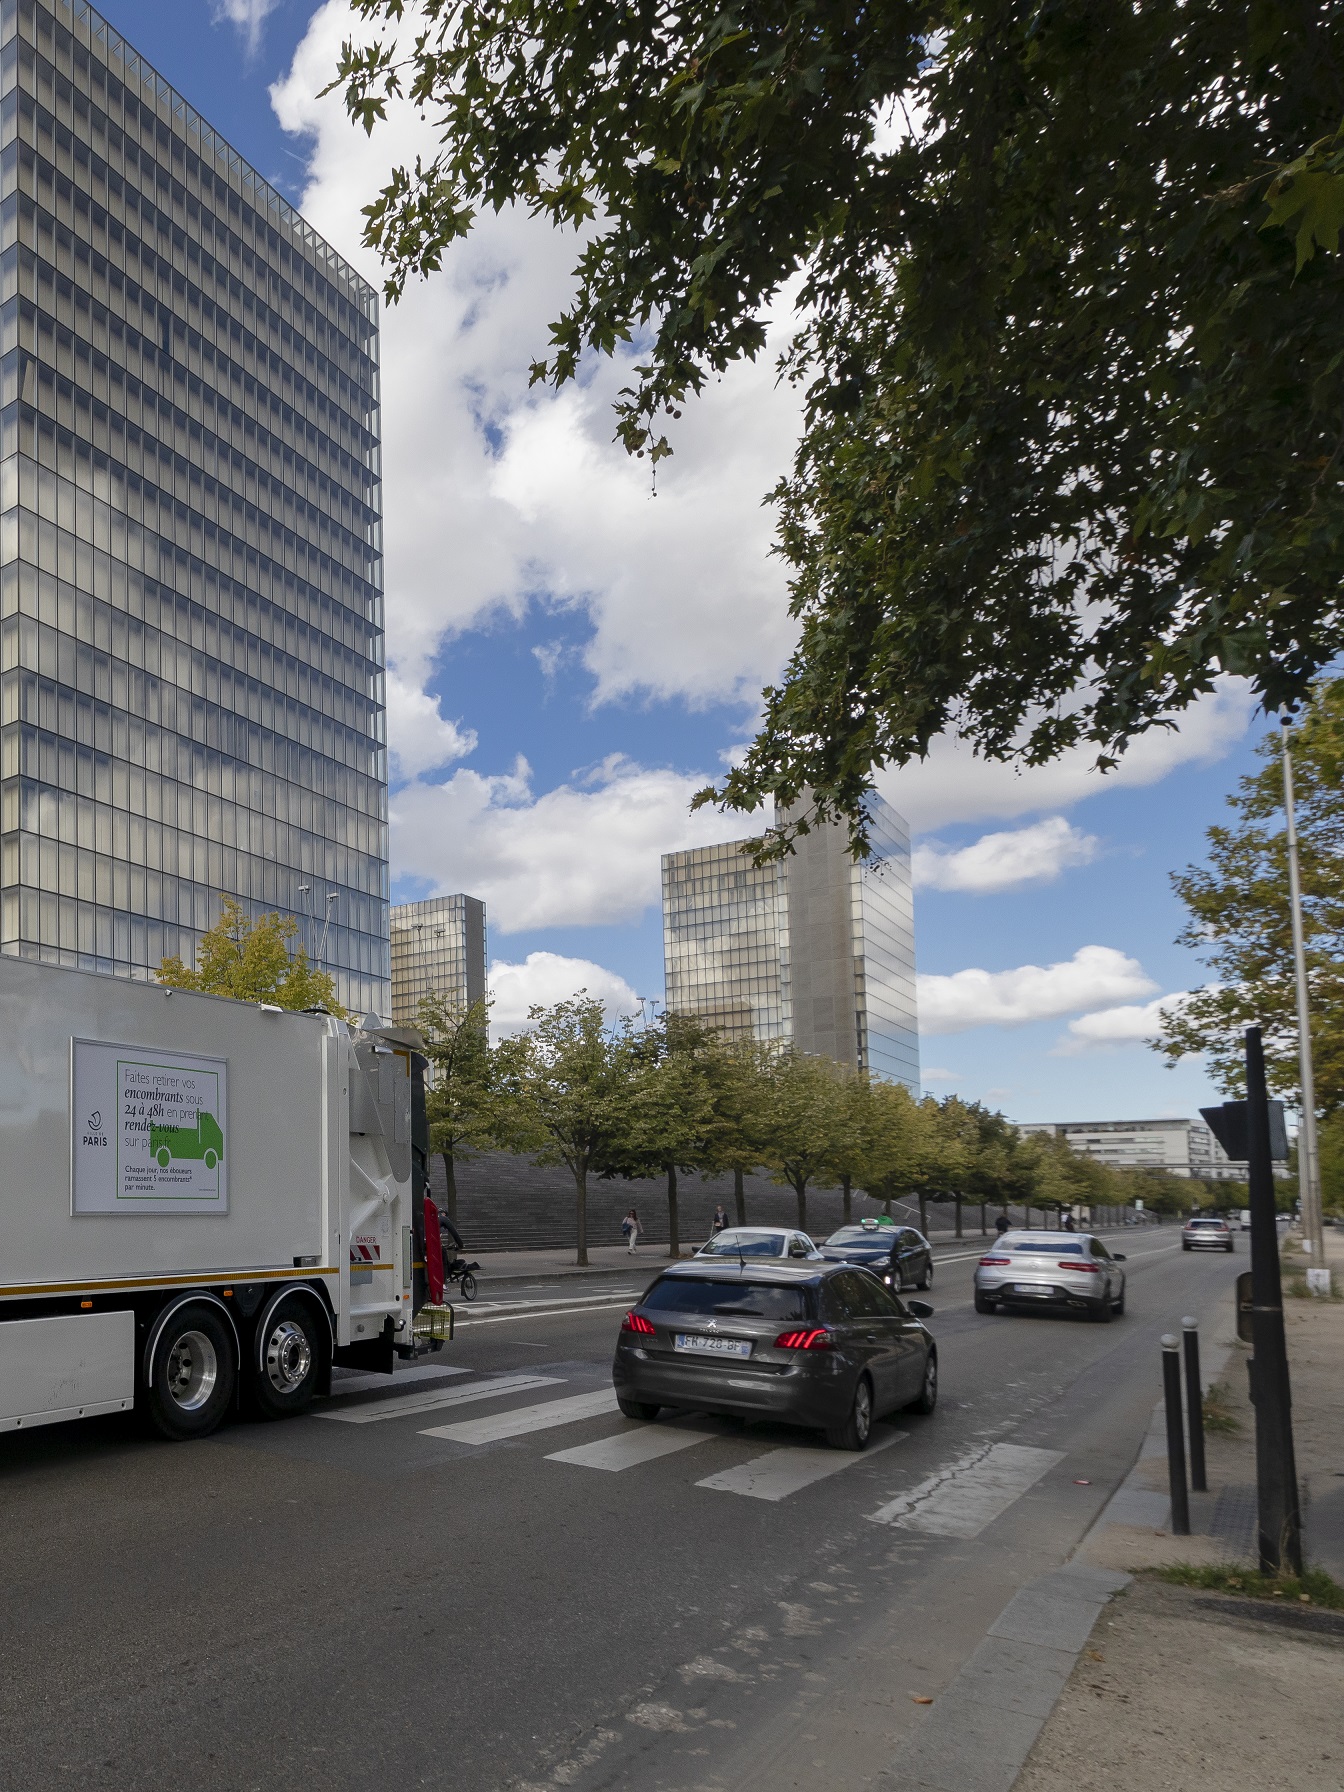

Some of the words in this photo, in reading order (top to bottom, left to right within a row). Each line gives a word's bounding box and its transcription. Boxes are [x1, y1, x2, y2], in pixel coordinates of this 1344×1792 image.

[125, 1069, 150, 1084] Faites
[152, 1074, 179, 1087] retirer
[181, 1080, 196, 1089] vos
[124, 1088, 184, 1103] encombrants
[185, 1095, 204, 1105] sous
[124, 1105, 136, 1118] 24
[138, 1102, 145, 1116] à
[146, 1103, 164, 1118] 48h
[166, 1109, 178, 1118] en
[124, 1118, 179, 1133] rendez-vous
[83, 1136, 107, 1146] PARIS
[124, 1137, 138, 1147] sur
[141, 1136, 171, 1151] paris.fr
[125, 1165, 145, 1174] Chaque
[146, 1166, 158, 1174] jour,
[124, 1183, 134, 1191] par
[135, 1183, 156, 1191] minute.
